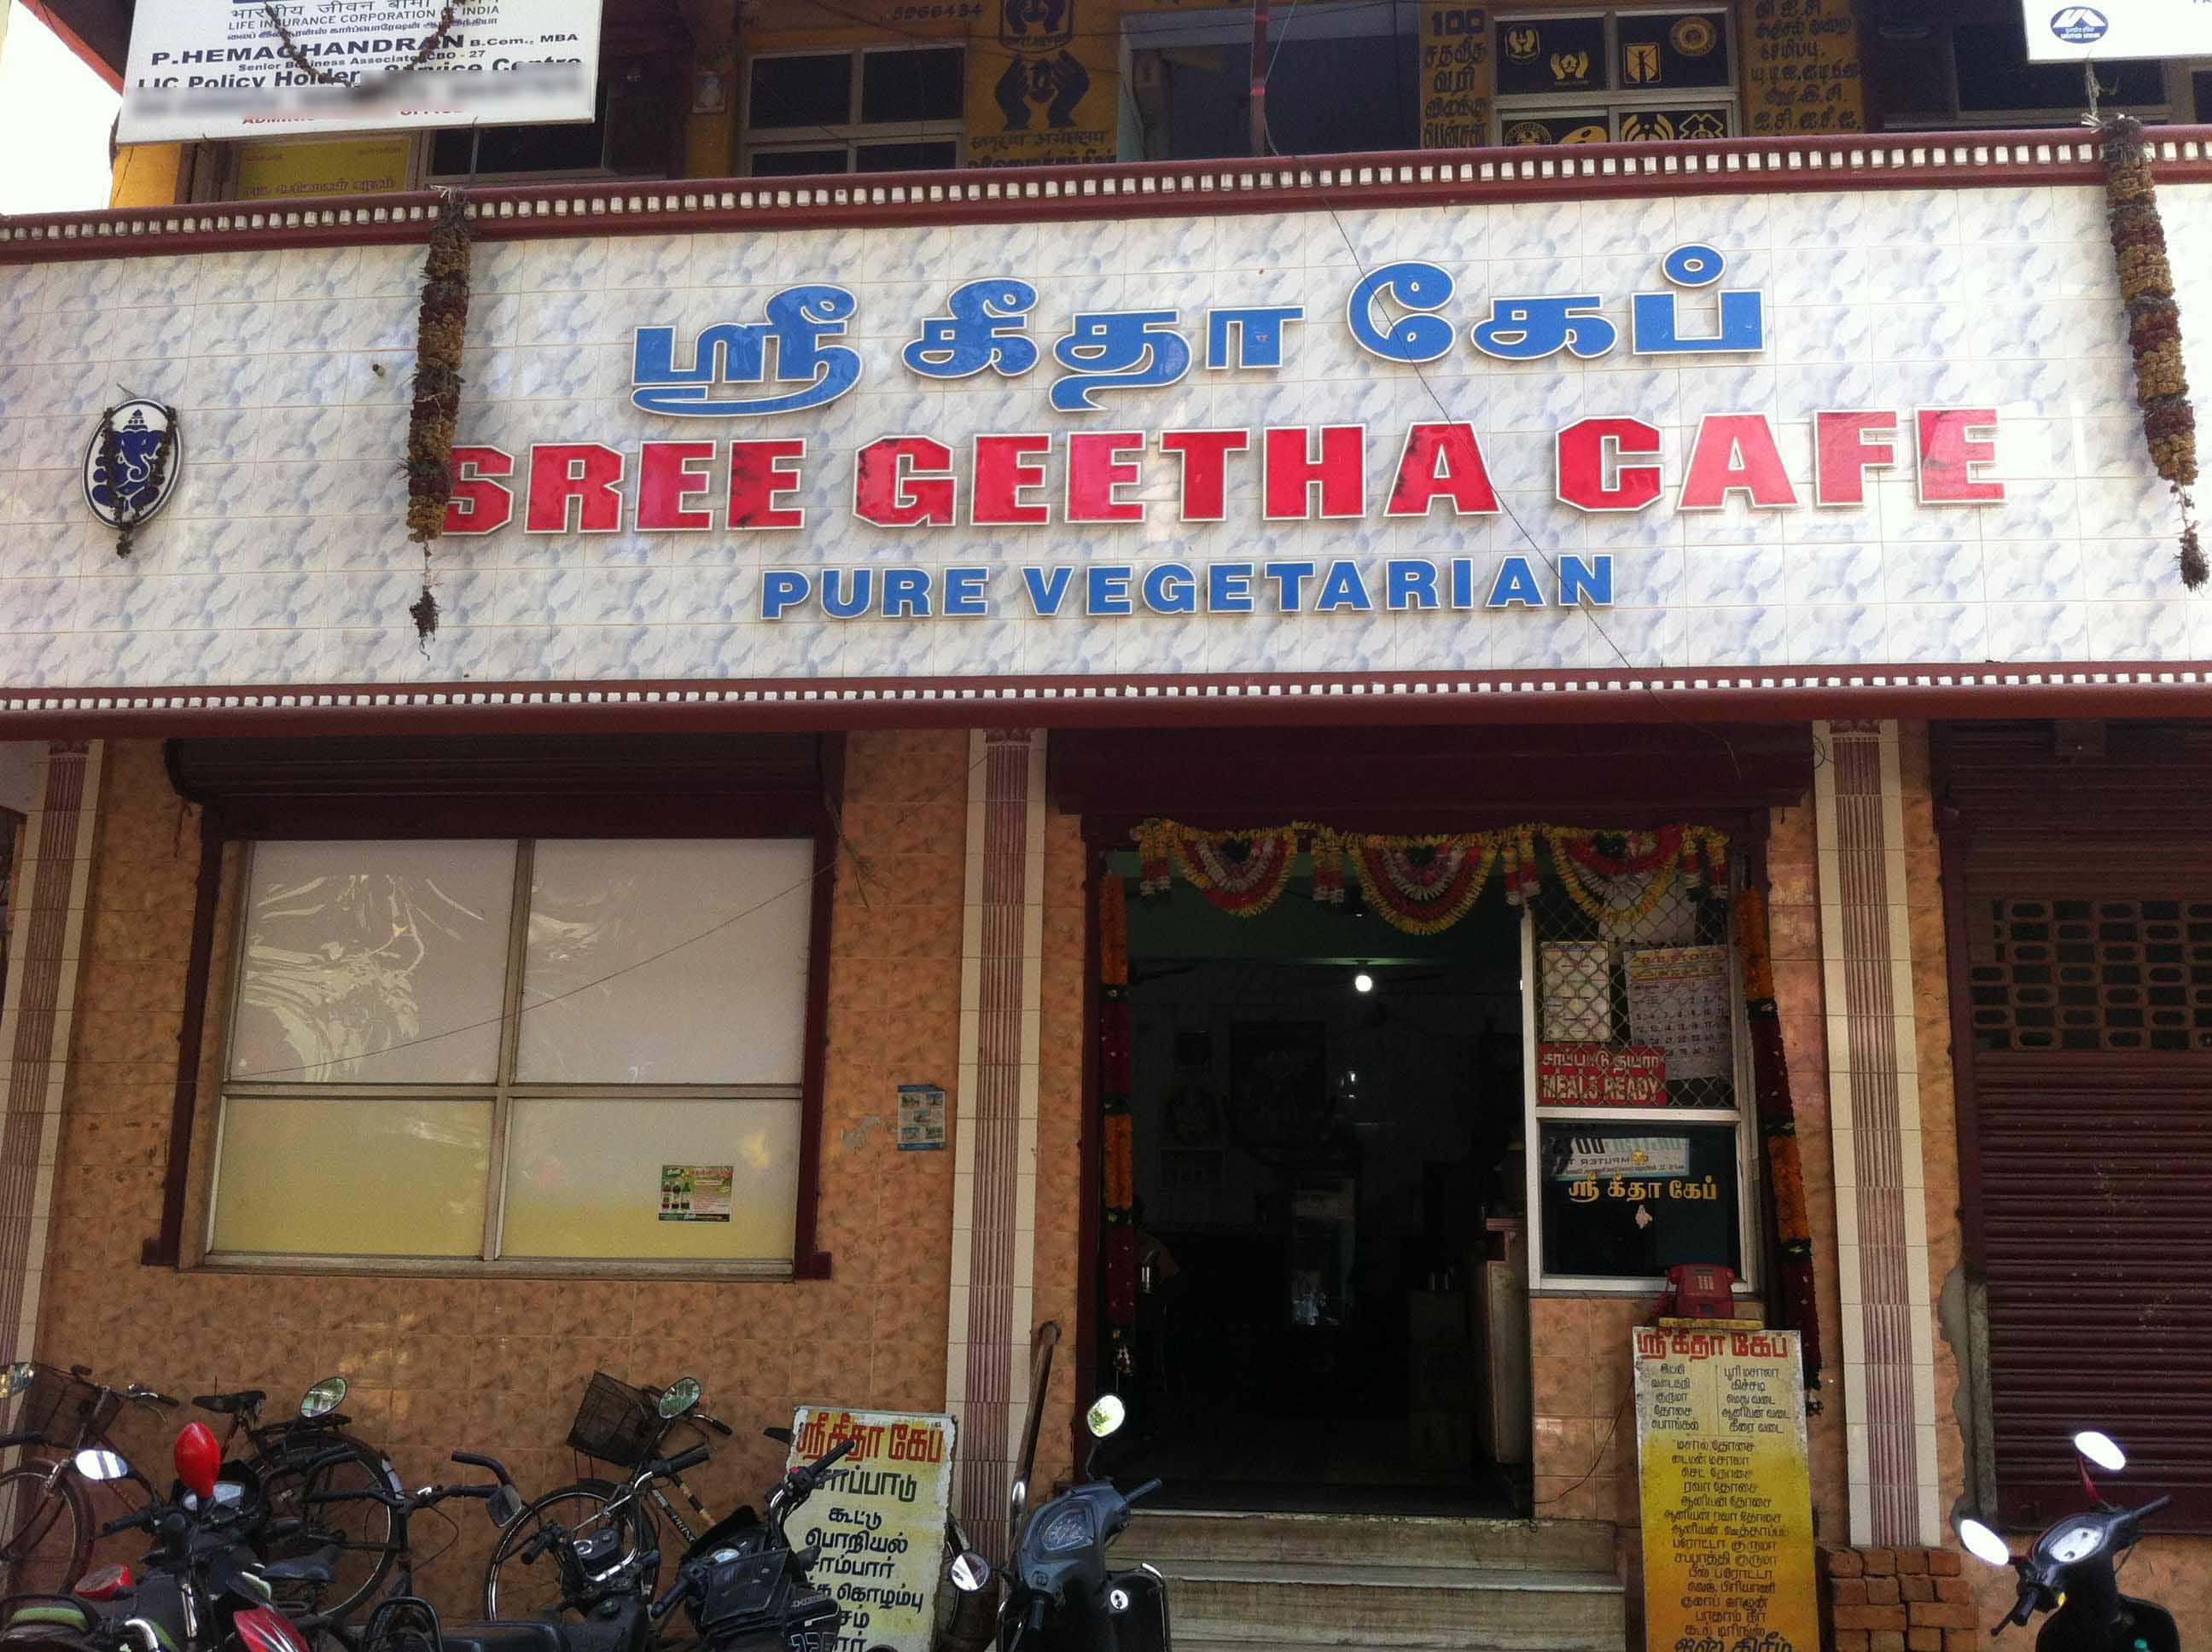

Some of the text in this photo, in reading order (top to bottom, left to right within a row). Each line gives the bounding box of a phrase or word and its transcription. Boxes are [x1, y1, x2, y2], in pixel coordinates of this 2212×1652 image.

[229, 20, 255, 31] LIFE
[259, 15, 336, 29] INURANCE
[341, 9, 436, 23] CORPORATION
[462, 4, 499, 15] INDIA
[231, 3, 306, 20] भारीय
[539, 32, 579, 44] MBA
[238, 62, 282, 73] Senior
[285, 59, 346, 70] Buiness
[426, 51, 456, 61] CBO
[469, 49, 486, 59] 27
[901, 276, 1304, 412] கீதா
[1347, 241, 1767, 364] கேப்
[439, 405, 2007, 535] SREE GEETHA CAFE
[760, 554, 1615, 620] PURE VEGETARIAN
[1542, 1074, 1659, 1101] MEALS READY
[1668, 1174, 1720, 1201] கேப்
[828, 1506, 882, 1531] கூட்டு
[805, 1527, 909, 1555] பொறியல்
[814, 1554, 895, 1579] ாம்பார்
[836, 1582, 924, 1614] கொழம்பு
[840, 1603, 870, 1629] சம்
